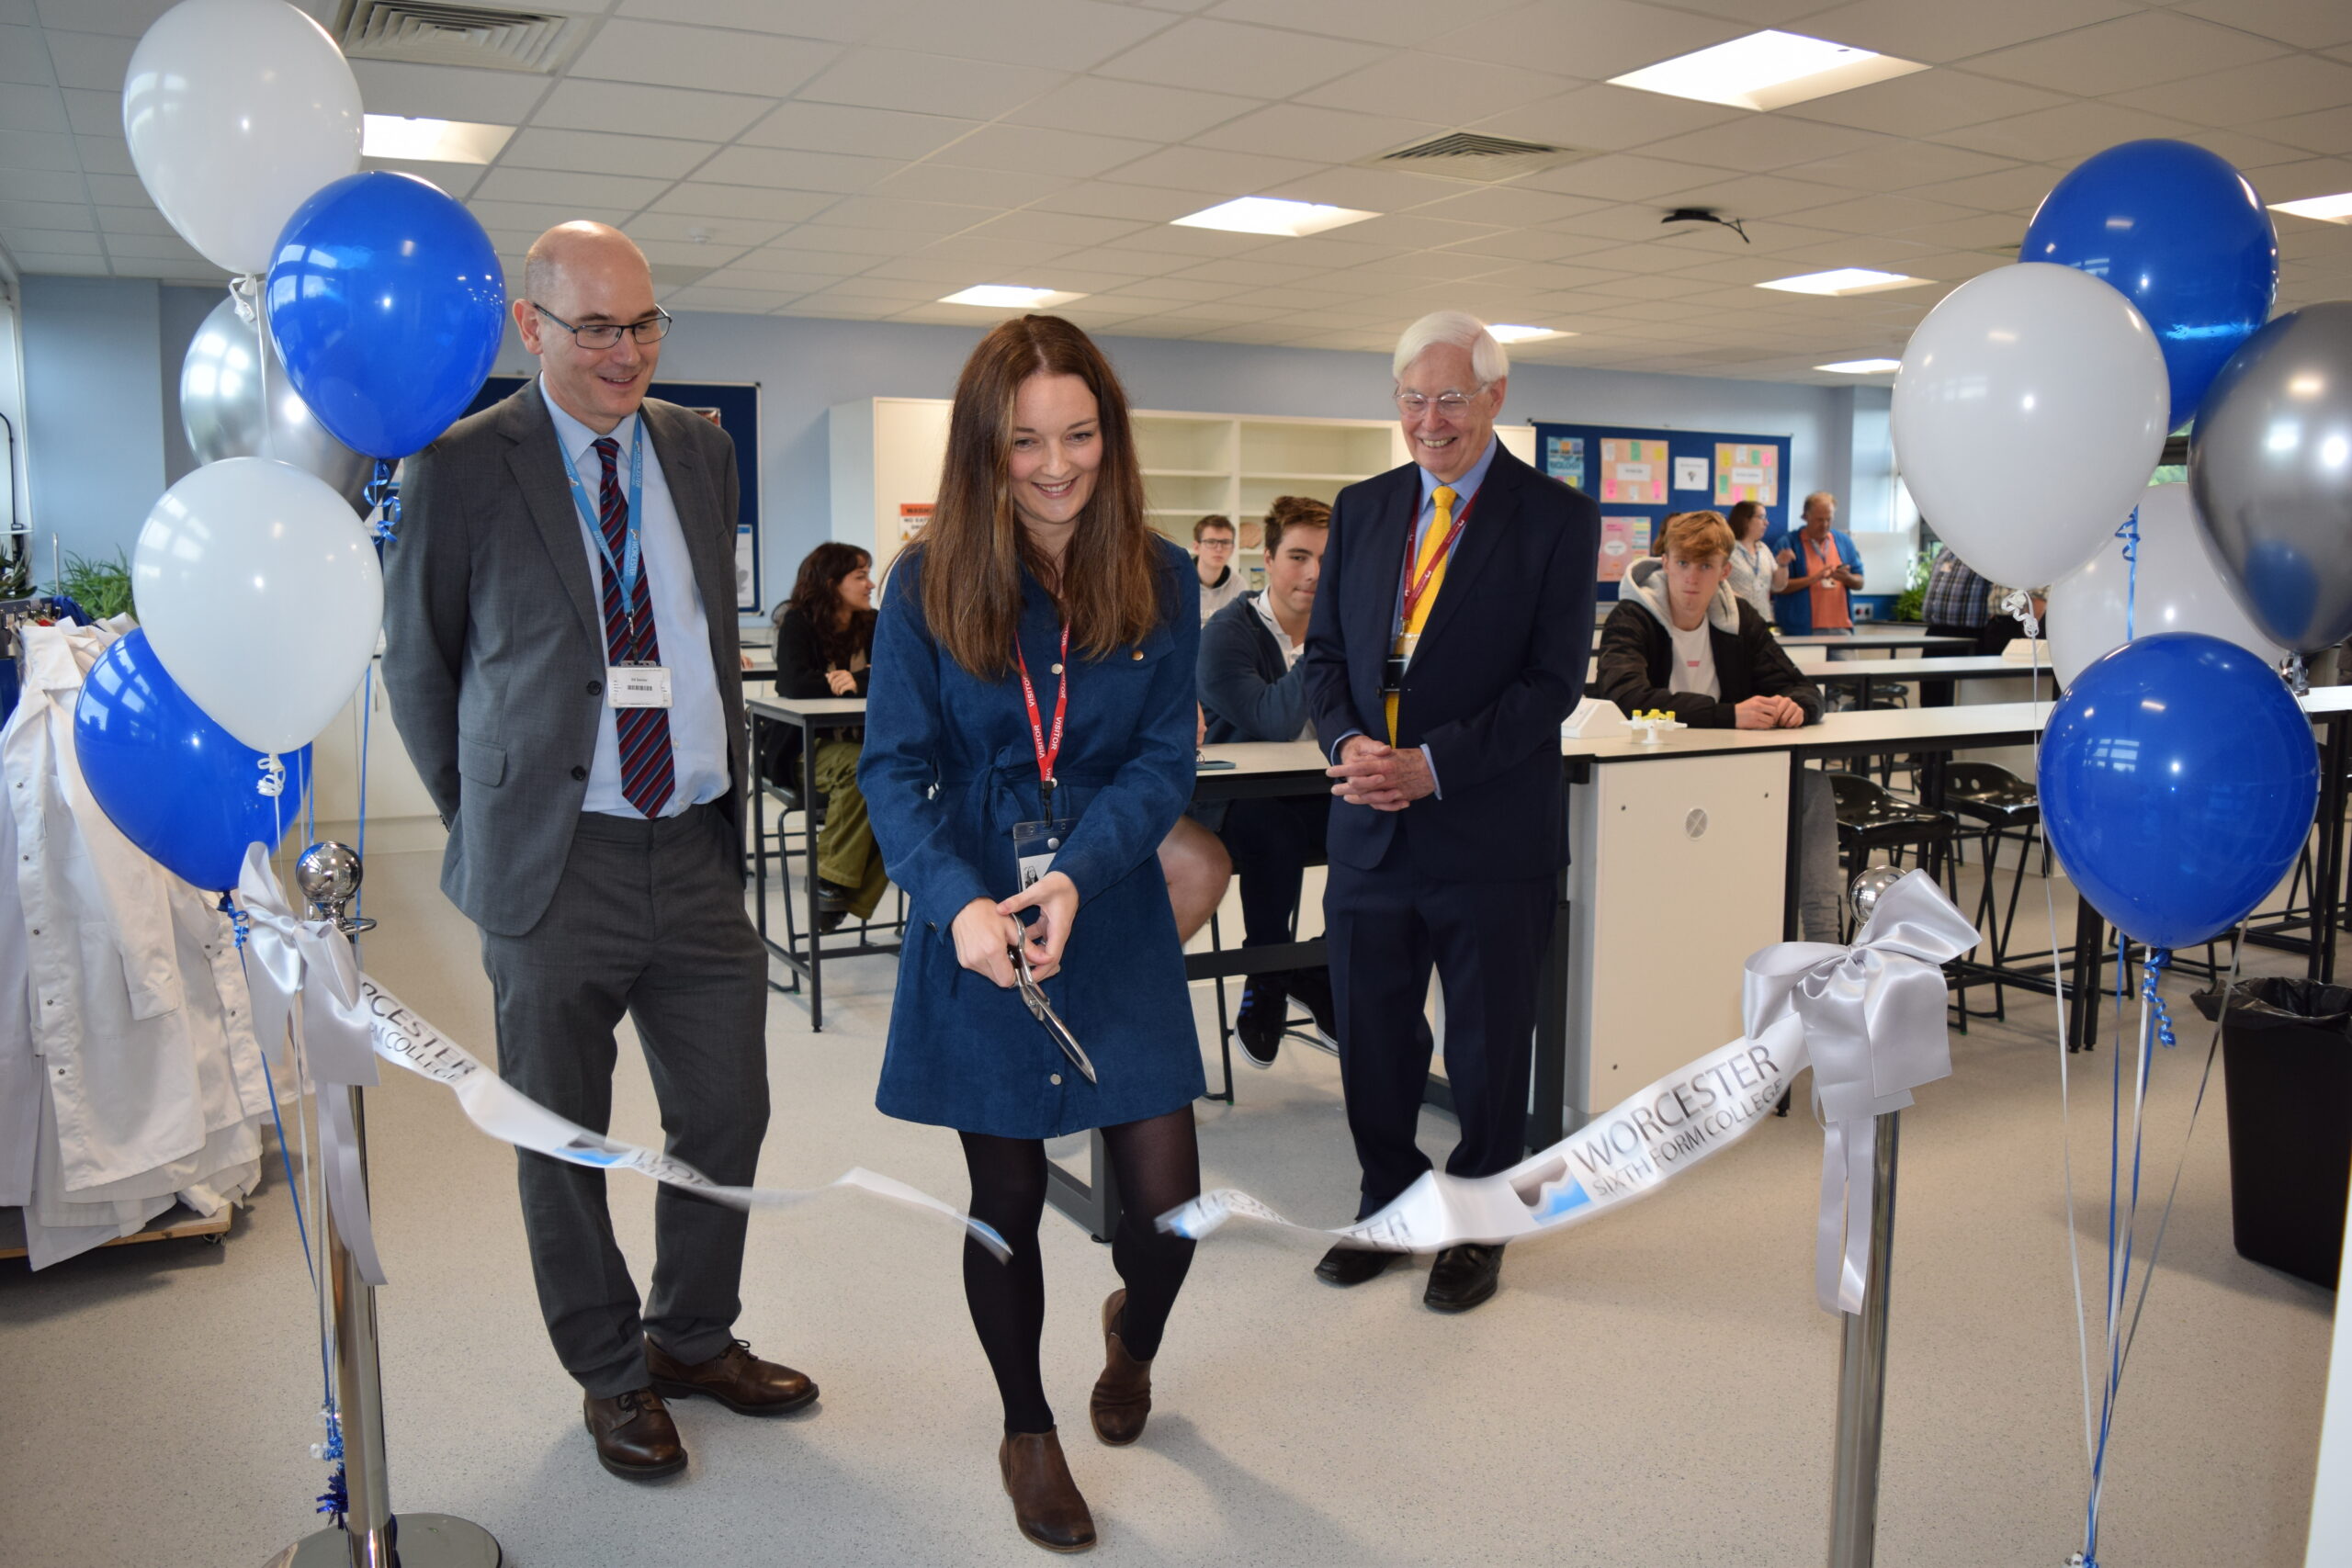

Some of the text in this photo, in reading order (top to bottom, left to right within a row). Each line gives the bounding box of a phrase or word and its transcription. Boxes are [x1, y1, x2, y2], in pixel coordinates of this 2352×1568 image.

[628, 540, 639, 577] WORCESTER
[1034, 724, 1046, 759] VISITOR
[1051, 716, 1063, 750] VISITOR
[1571, 1044, 1780, 1175] WORCESTER
[1592, 1077, 1785, 1197] SIXTH FORM COLLEGE
